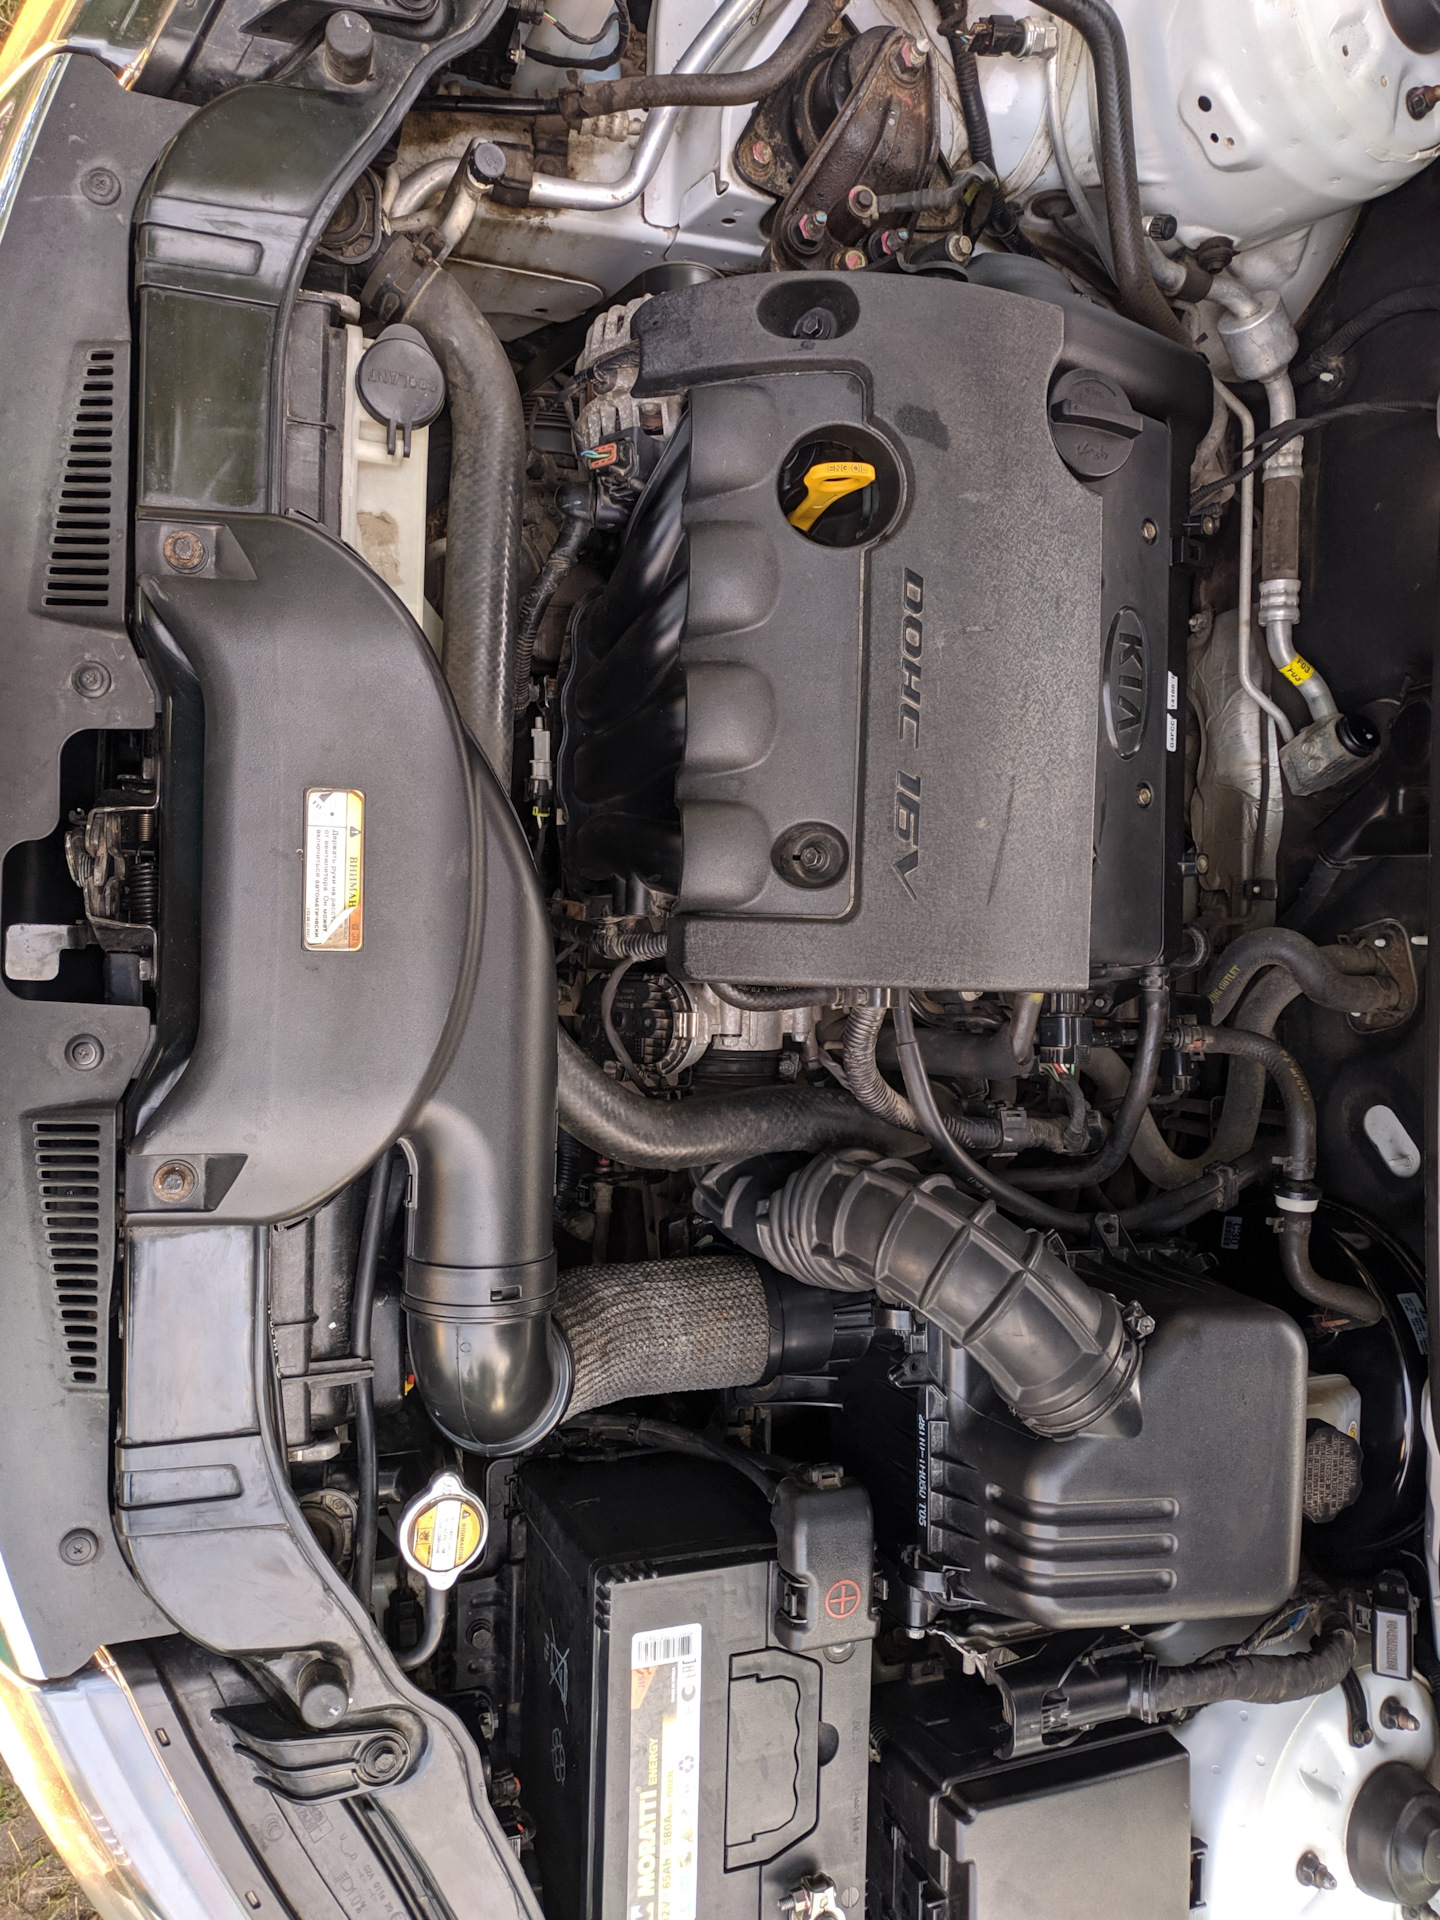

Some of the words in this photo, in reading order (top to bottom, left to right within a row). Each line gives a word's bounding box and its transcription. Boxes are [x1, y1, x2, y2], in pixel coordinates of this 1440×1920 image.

[368, 369, 437, 392] COOLANT
[900, 567, 923, 749] DOHC
[1297, 659, 1310, 673] F03
[1117, 633, 1143, 733] KIA
[324, 830, 329, 838] от
[892, 770, 921, 901] 16V
[331, 887, 336, 896] на
[348, 857, 358, 908] ВНИМАН
[323, 896, 328, 906] Он
[648, 1738, 658, 1786] ENERGY
[637, 1790, 657, 1897] MORATTI
[663, 1815, 672, 1845] 580A
[662, 1858, 671, 1889] 65Ah
